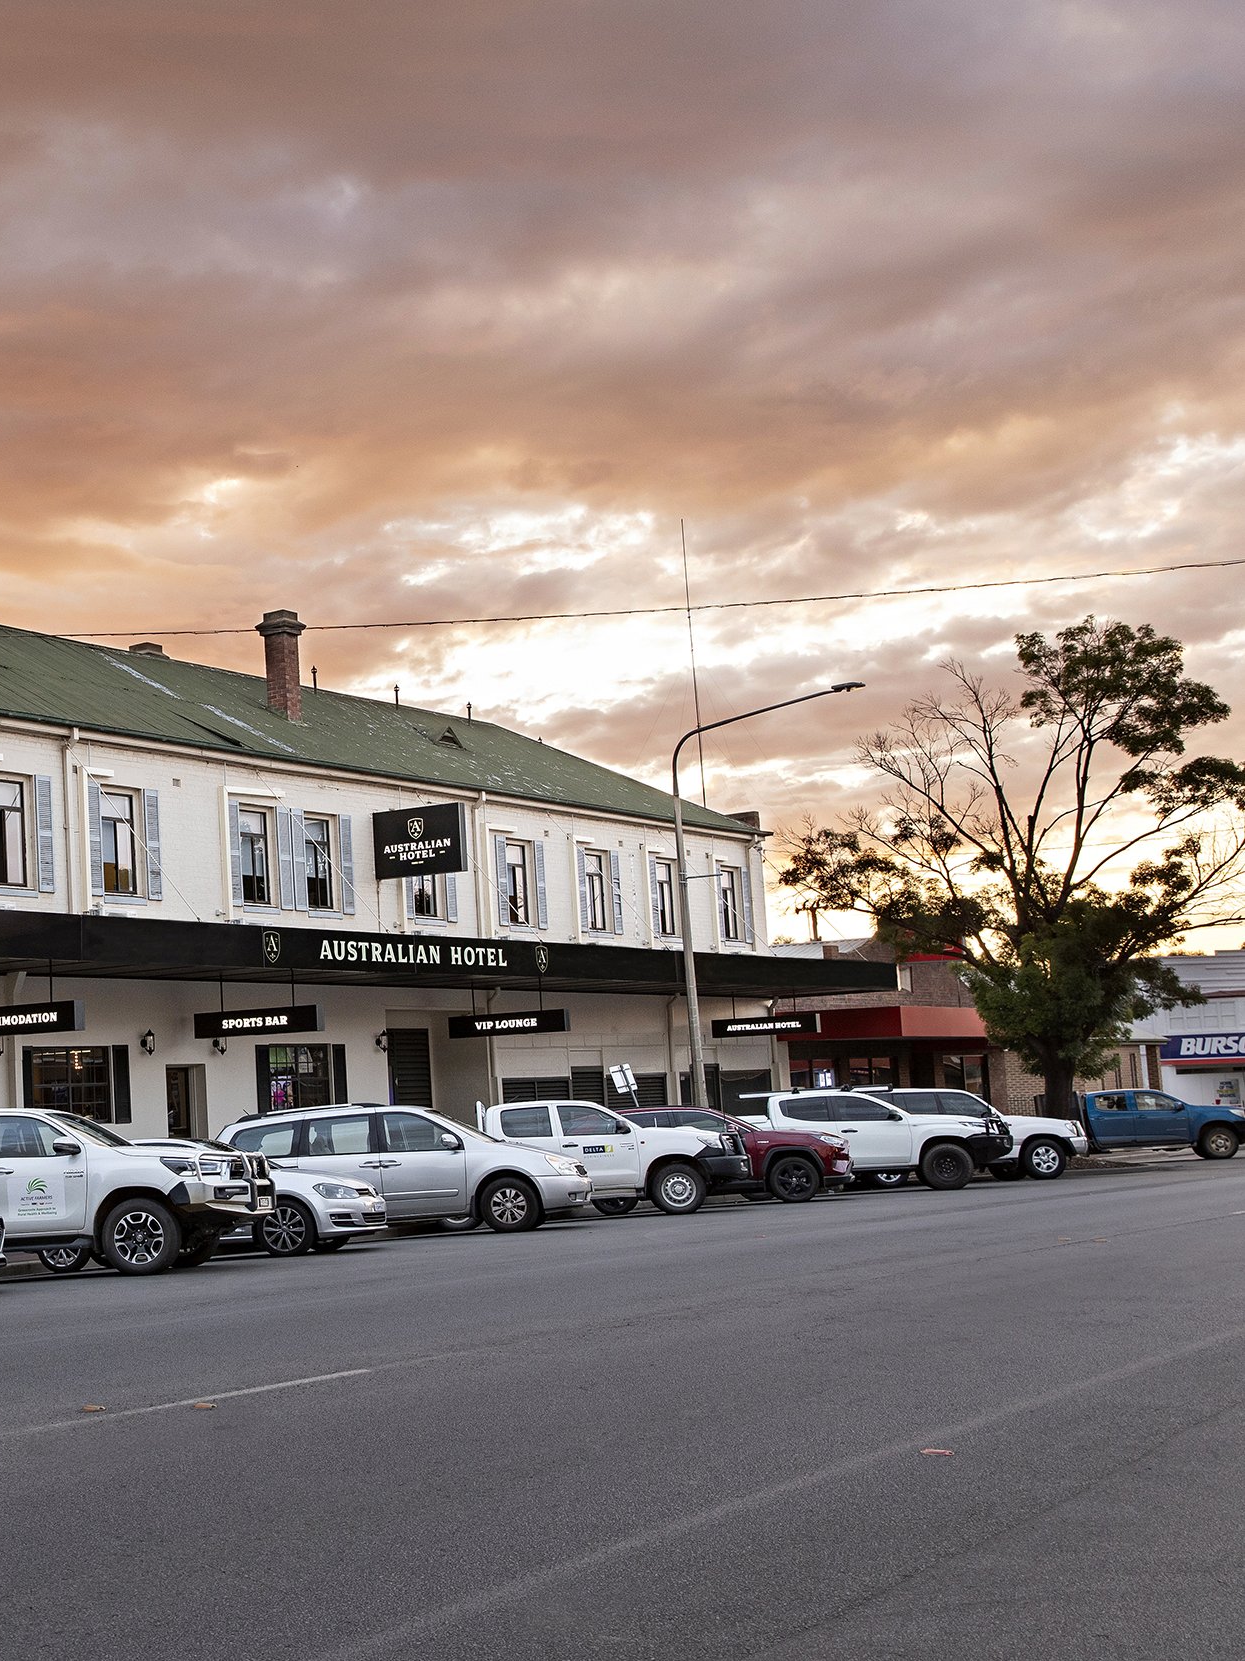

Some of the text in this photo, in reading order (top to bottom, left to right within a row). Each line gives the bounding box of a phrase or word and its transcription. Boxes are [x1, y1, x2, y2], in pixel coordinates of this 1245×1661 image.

[383, 838, 451, 854] AUSTRALIAN
[399, 849, 435, 861] HOTEL
[319, 939, 508, 967] AUSTRALIAN HOTEL
[221, 1015, 288, 1030] SPORTS BAR
[474, 1017, 538, 1031] VIP LOUNGE
[726, 1021, 802, 1032] AUSTRALIAN HOTEL
